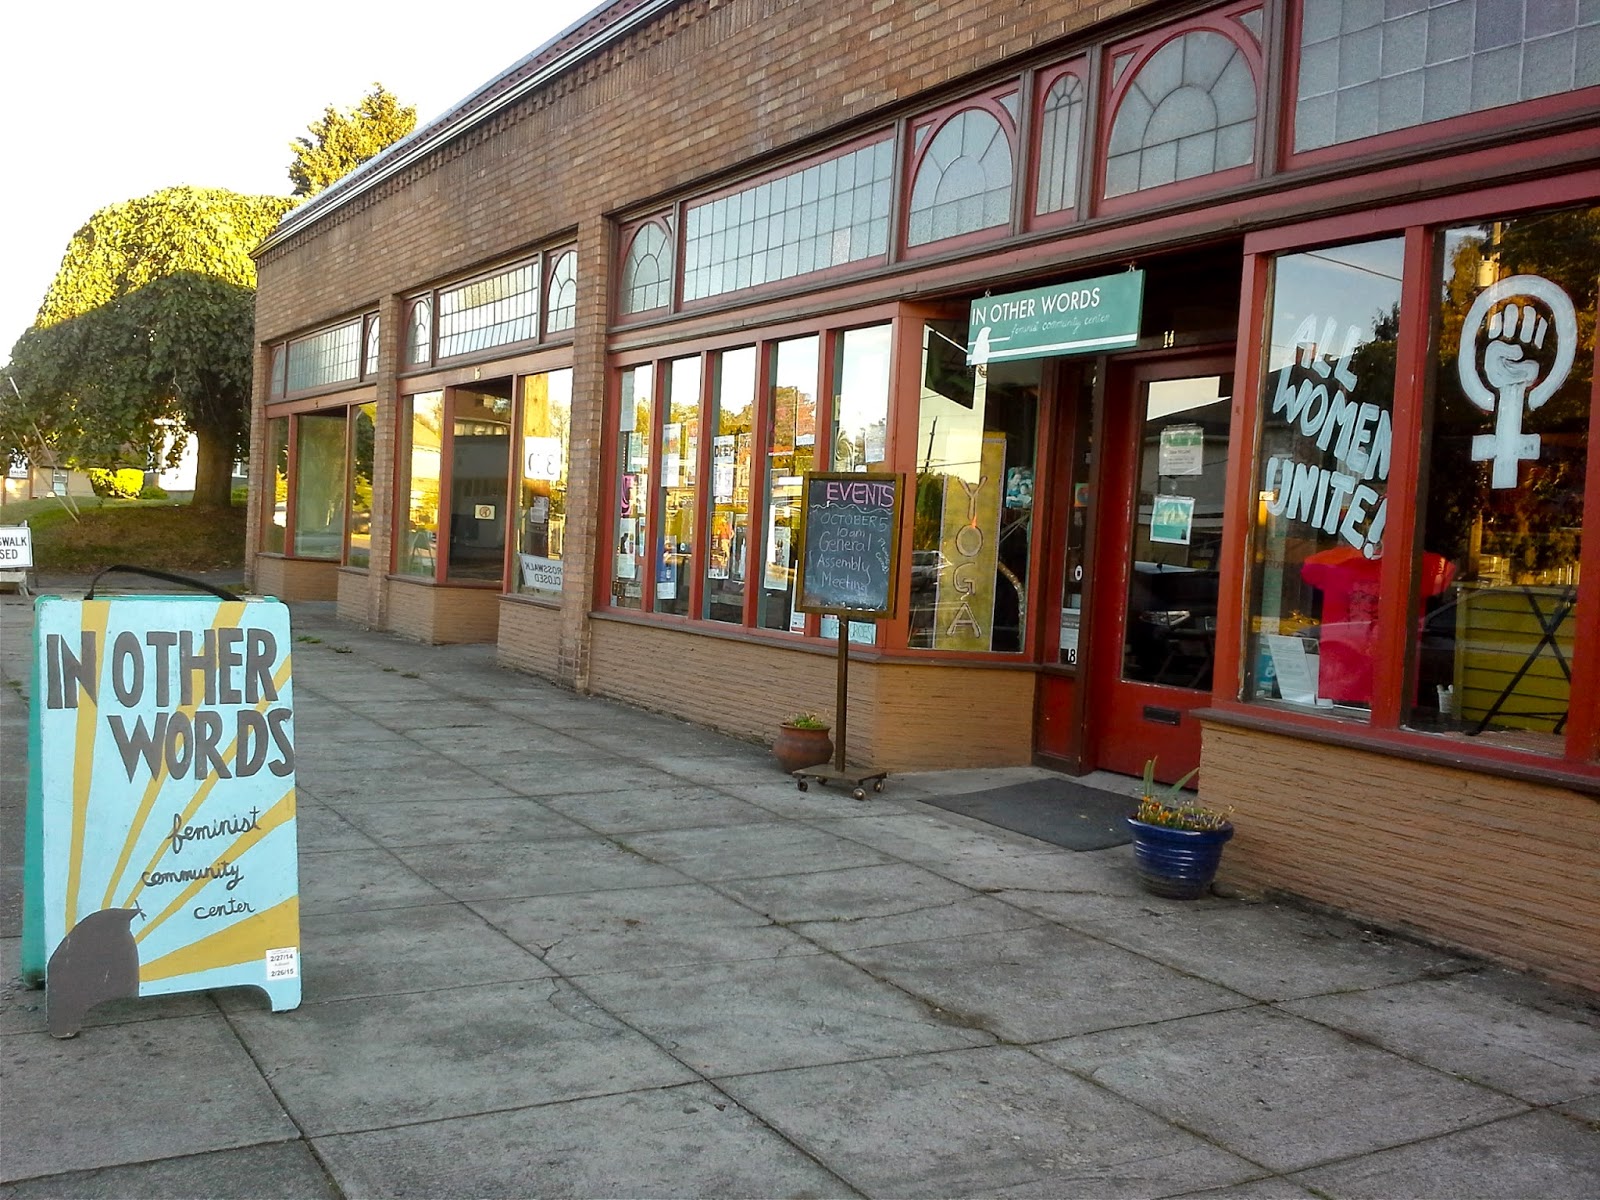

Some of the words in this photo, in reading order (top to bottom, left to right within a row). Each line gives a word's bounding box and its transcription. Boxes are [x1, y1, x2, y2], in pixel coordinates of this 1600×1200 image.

[971, 306, 987, 326] IN
[990, 299, 1035, 323] OTHER
[1041, 287, 1101, 315] WORDS
[1279, 313, 1361, 392] ALL
[1272, 364, 1392, 481] WOMEN
[826, 482, 895, 508] EVENTS
[1265, 456, 1388, 561] UNITE!
[820, 513, 879, 528] OCTOBER
[818, 530, 873, 552] General
[946, 475, 989, 639] YOGA
[816, 553, 872, 587] Assembly
[821, 570, 869, 595] Meeting
[46, 630, 98, 710] IN
[112, 627, 279, 708] OTHER
[106, 707, 295, 784] WORDS
[167, 806, 261, 854] feminist
[141, 860, 245, 891] community
[193, 897, 256, 919] center
